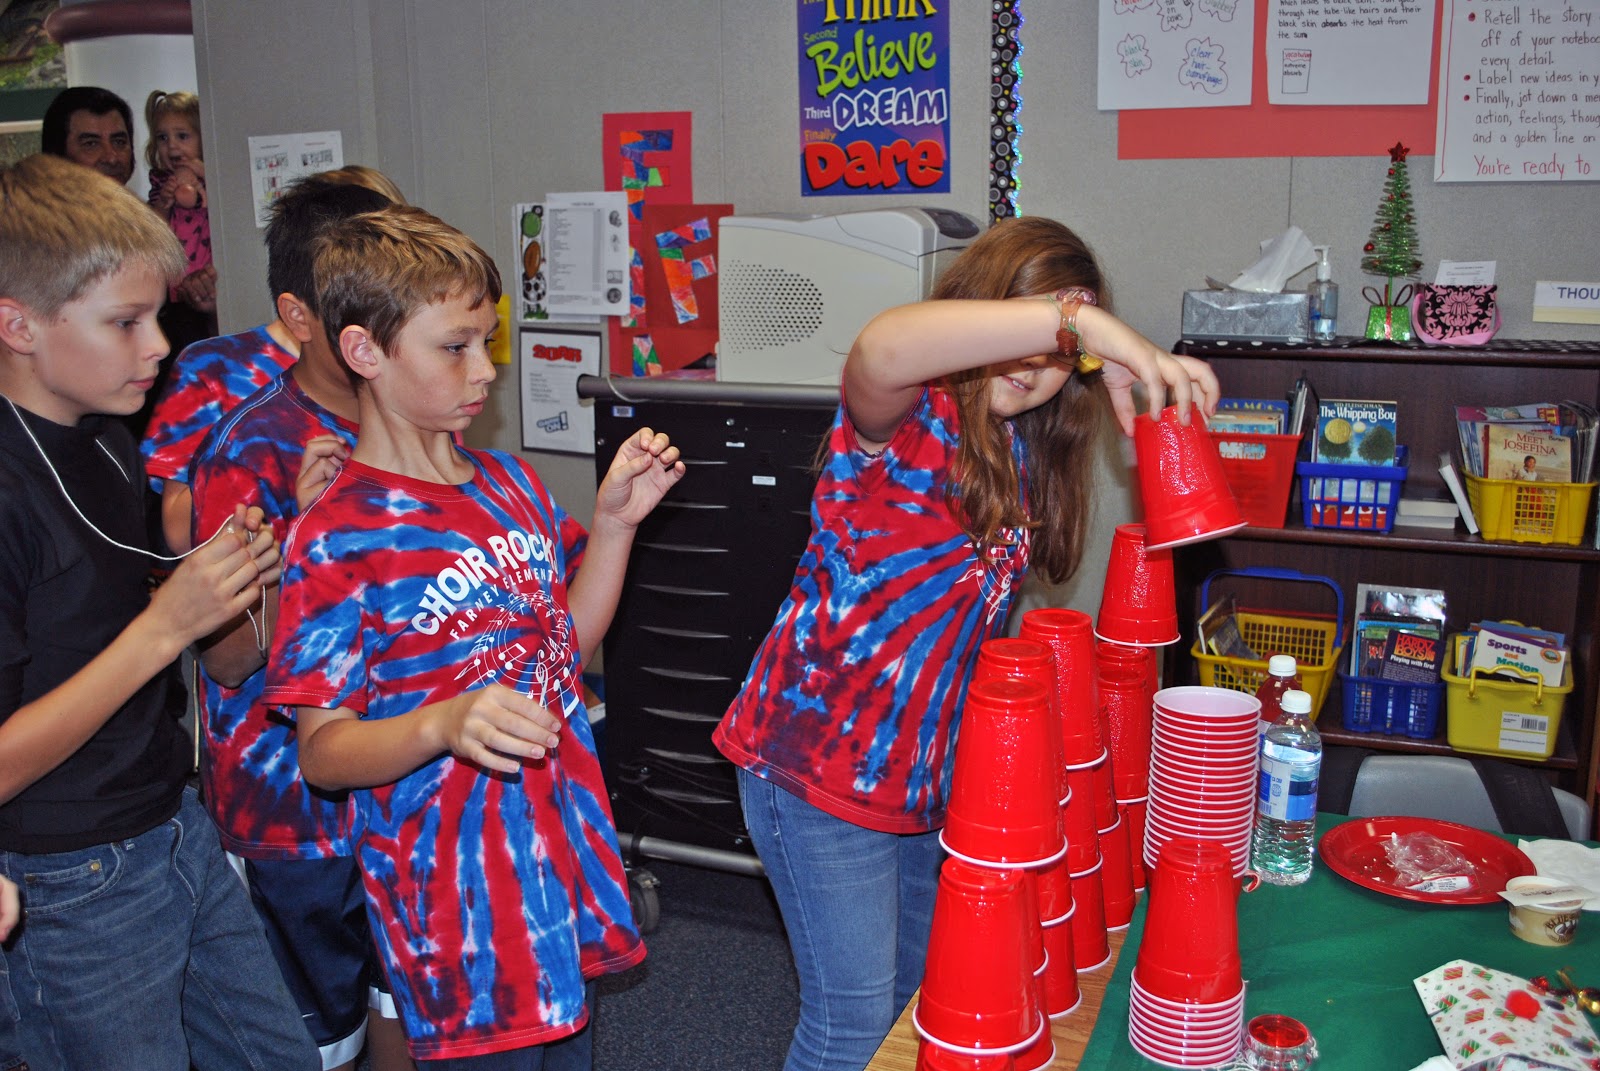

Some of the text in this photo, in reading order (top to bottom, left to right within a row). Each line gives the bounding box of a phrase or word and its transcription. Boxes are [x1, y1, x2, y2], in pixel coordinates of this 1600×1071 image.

[1278, 9, 1305, 20] through
[1359, 6, 1380, 14] hairs
[1383, 6, 1398, 14] and
[1401, 6, 1422, 14] their
[1278, 20, 1297, 28] black
[1301, 20, 1317, 28] skin
[1350, 18, 1365, 26] the
[1367, 17, 1384, 26] heat
[1387, 16, 1408, 25] from
[1485, 6, 1592, 27] Retell the story
[803, 26, 838, 46] Second
[1278, 31, 1290, 39] the
[1481, 29, 1504, 48] off
[1510, 31, 1524, 47] of
[1531, 36, 1556, 51] your
[806, 29, 937, 99] Believe
[1481, 57, 1510, 72] every
[1479, 70, 1514, 85] Label
[1520, 76, 1540, 85] new
[1545, 71, 1573, 84] ideas
[1579, 72, 1590, 83] in
[1476, 87, 1515, 109] Finally,
[1517, 89, 1532, 108] jot
[1537, 91, 1566, 104] down
[1571, 94, 1578, 103] a
[804, 87, 948, 132] Third DREAM
[1475, 109, 1513, 127] action,
[1519, 109, 1567, 131] feelings,
[804, 128, 838, 142] Finally
[1472, 131, 1493, 144] and
[1500, 135, 1508, 144] a
[1514, 131, 1548, 149] golden
[1554, 131, 1576, 144] line
[805, 138, 945, 190] Dare
[1473, 153, 1591, 181] You're ready to
[1320, 405, 1397, 424] The Whipping Boy
[1503, 438, 1558, 456] JOSEFINA
[1517, 433, 1545, 445] MEET
[411, 546, 499, 636] CHOIR
[450, 584, 500, 641] FARNEY
[1487, 638, 1527, 655] Sports
[1503, 651, 1519, 660] and
[1390, 654, 1411, 665] Playing
[1495, 656, 1540, 673] Motion
